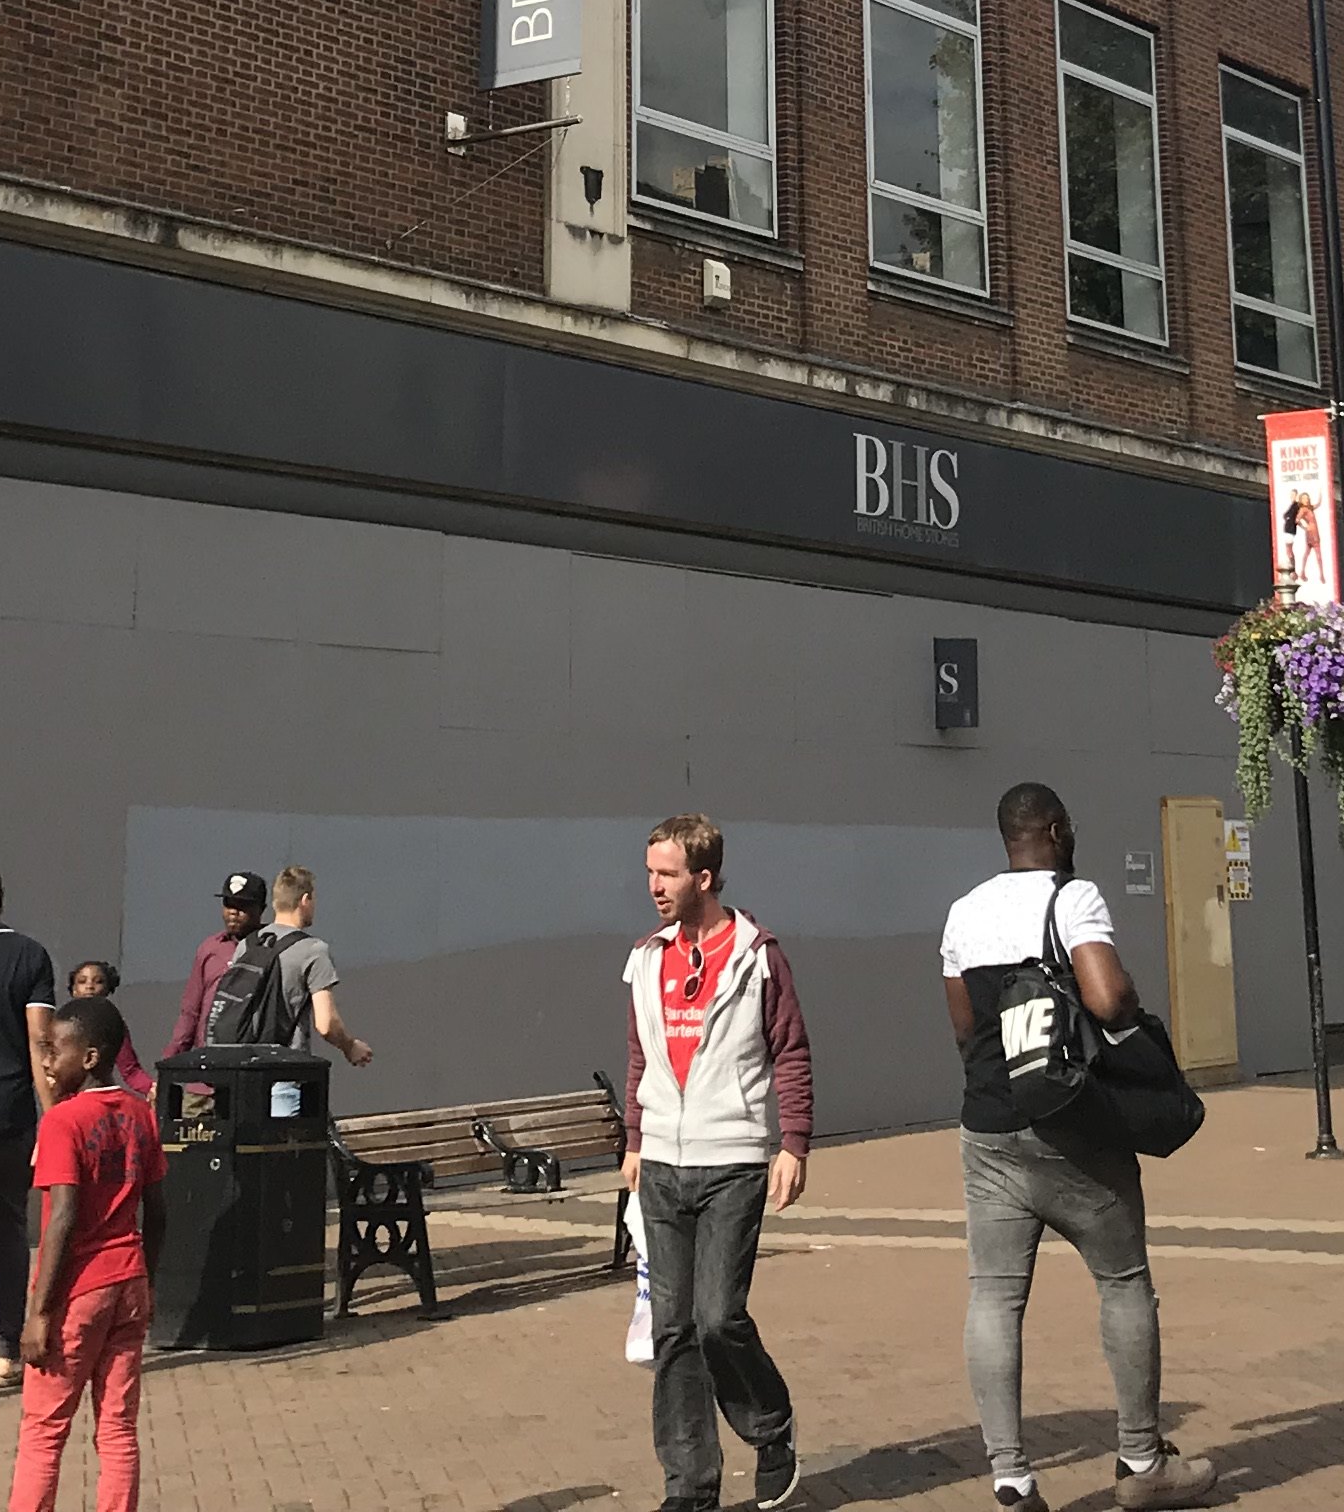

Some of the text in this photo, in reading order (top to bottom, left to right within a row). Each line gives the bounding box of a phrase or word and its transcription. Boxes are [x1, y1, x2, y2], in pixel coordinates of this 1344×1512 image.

[1280, 444, 1317, 458] KINKY
[1281, 458, 1319, 472] BOOTS
[853, 432, 960, 530] BHS
[178, 1124, 216, 1142] Litter
